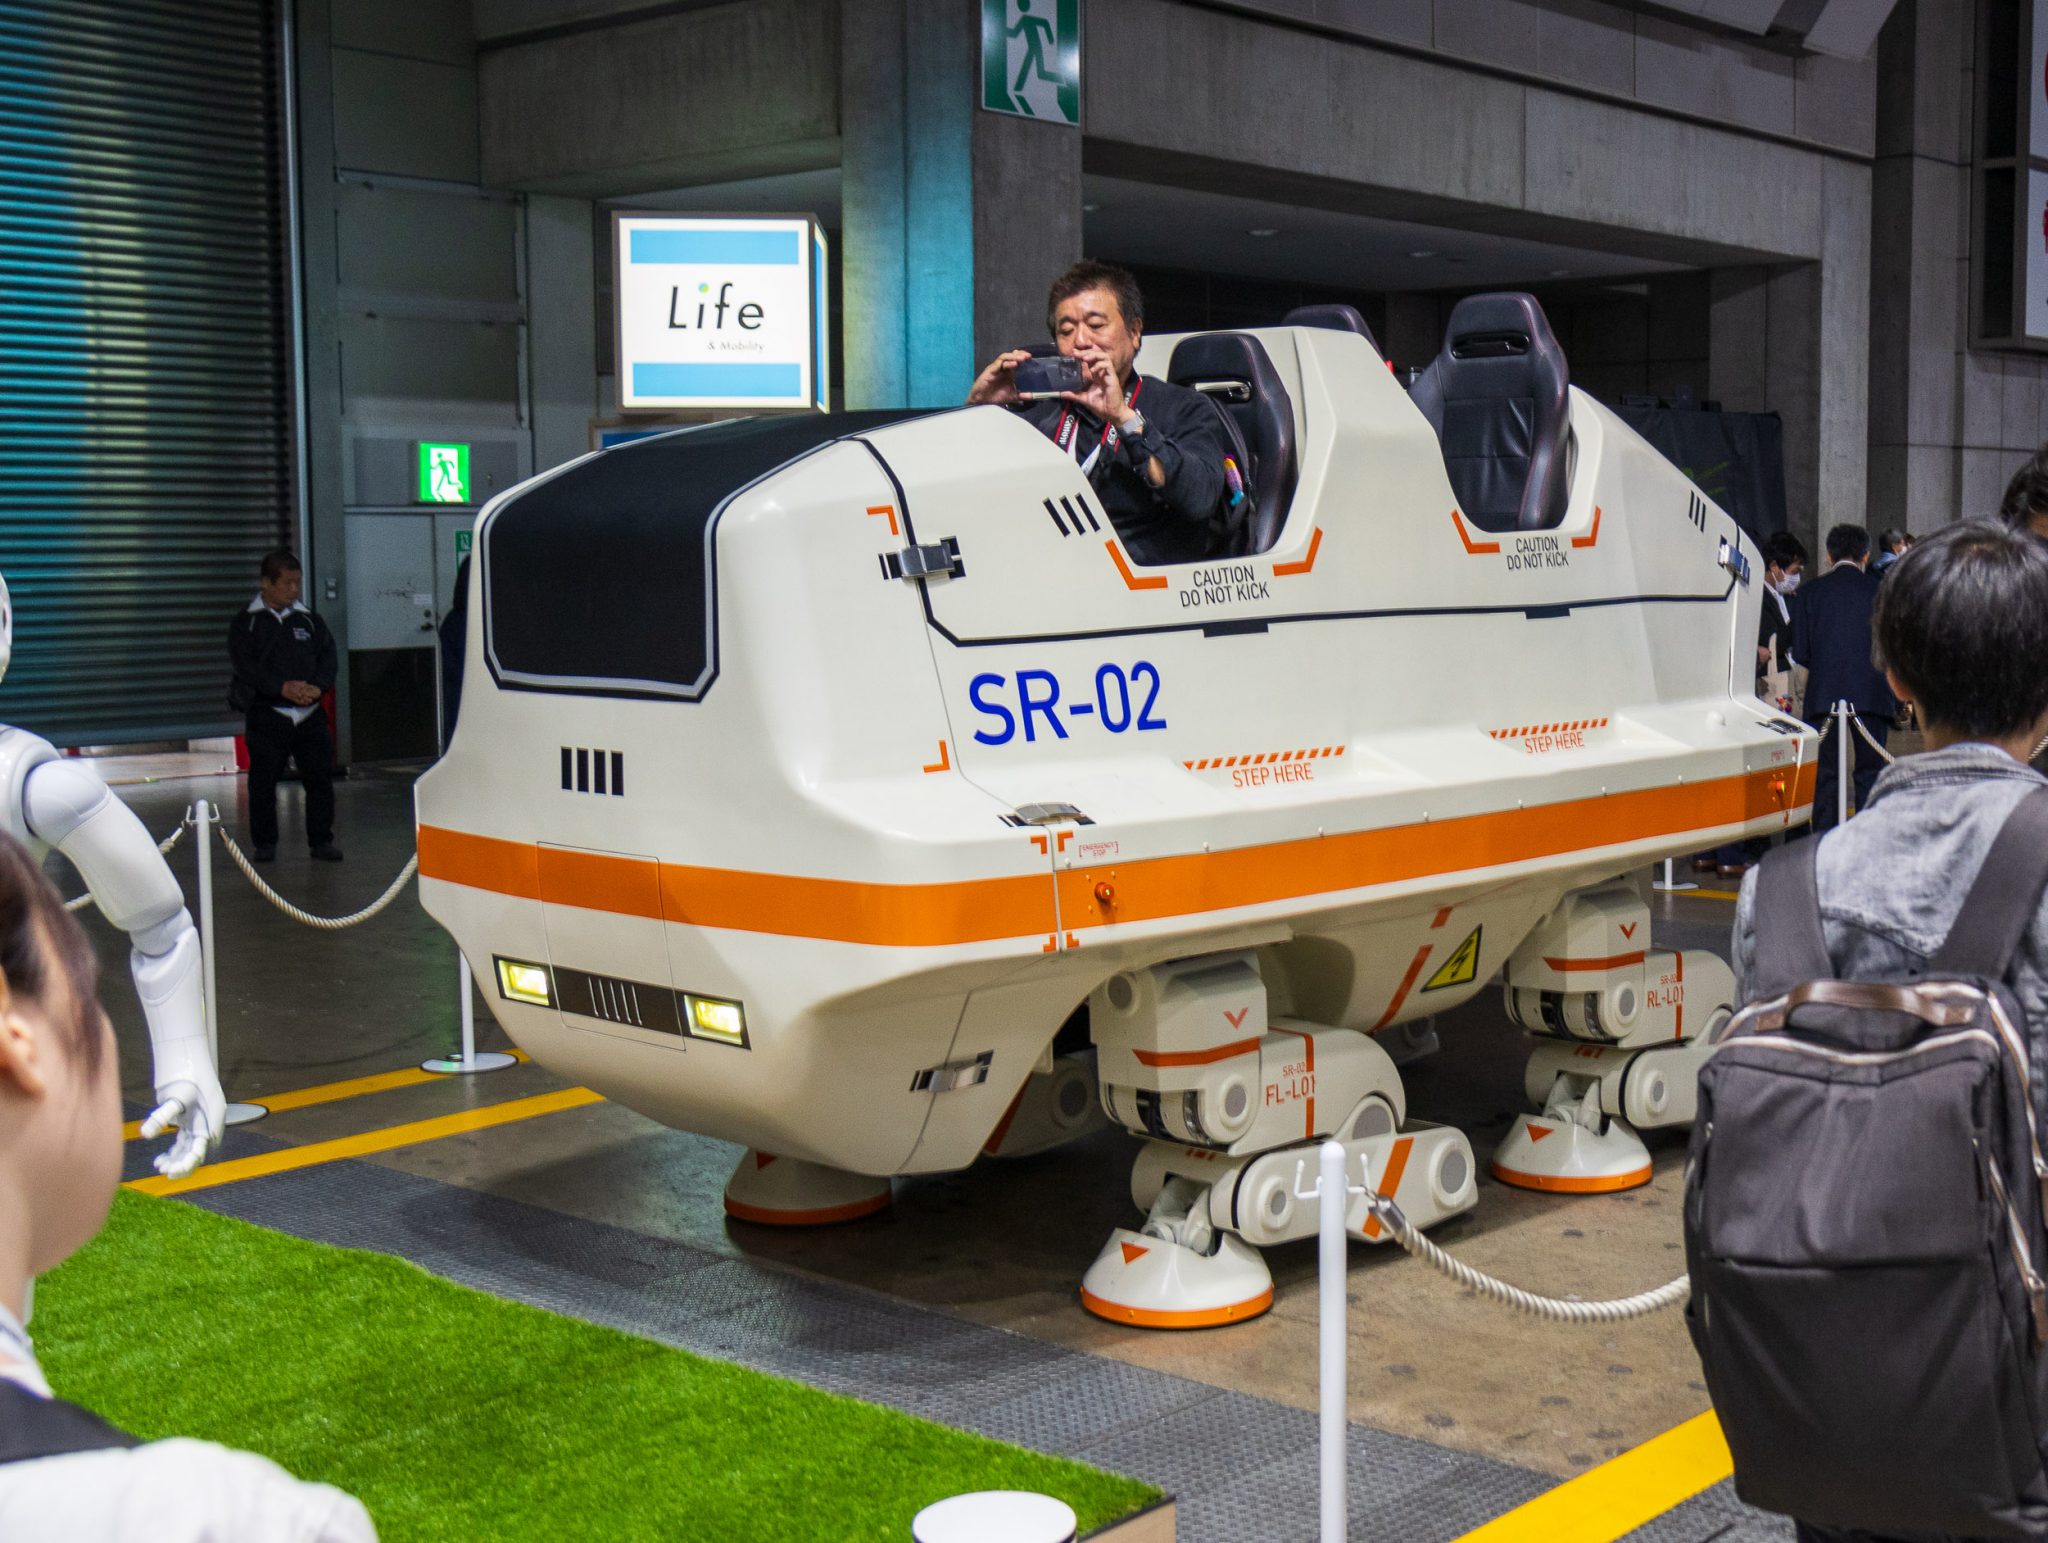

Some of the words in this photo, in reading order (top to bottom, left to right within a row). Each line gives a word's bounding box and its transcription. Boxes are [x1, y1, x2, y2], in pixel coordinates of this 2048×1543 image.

[668, 282, 764, 330] Life
[720, 340, 765, 352] Mobility
[1059, 415, 1075, 445] Canon
[1516, 536, 1559, 553] CAUTION
[1506, 554, 1521, 570] DO
[1523, 552, 1542, 569] NOT
[1545, 551, 1569, 567] KICK
[1193, 565, 1255, 587] CAUTION
[1180, 589, 1200, 607] DO
[1204, 585, 1232, 605] NOT
[1236, 581, 1270, 600] KICK
[969, 660, 1167, 745] SR-02
[1525, 735, 1552, 753] STEP
[1555, 731, 1584, 750] HERE
[1232, 767, 1270, 788] STEP
[1273, 762, 1314, 783] HERE
[1283, 1061, 1305, 1077] SR-02
[1266, 1074, 1315, 1106] FL-L01
